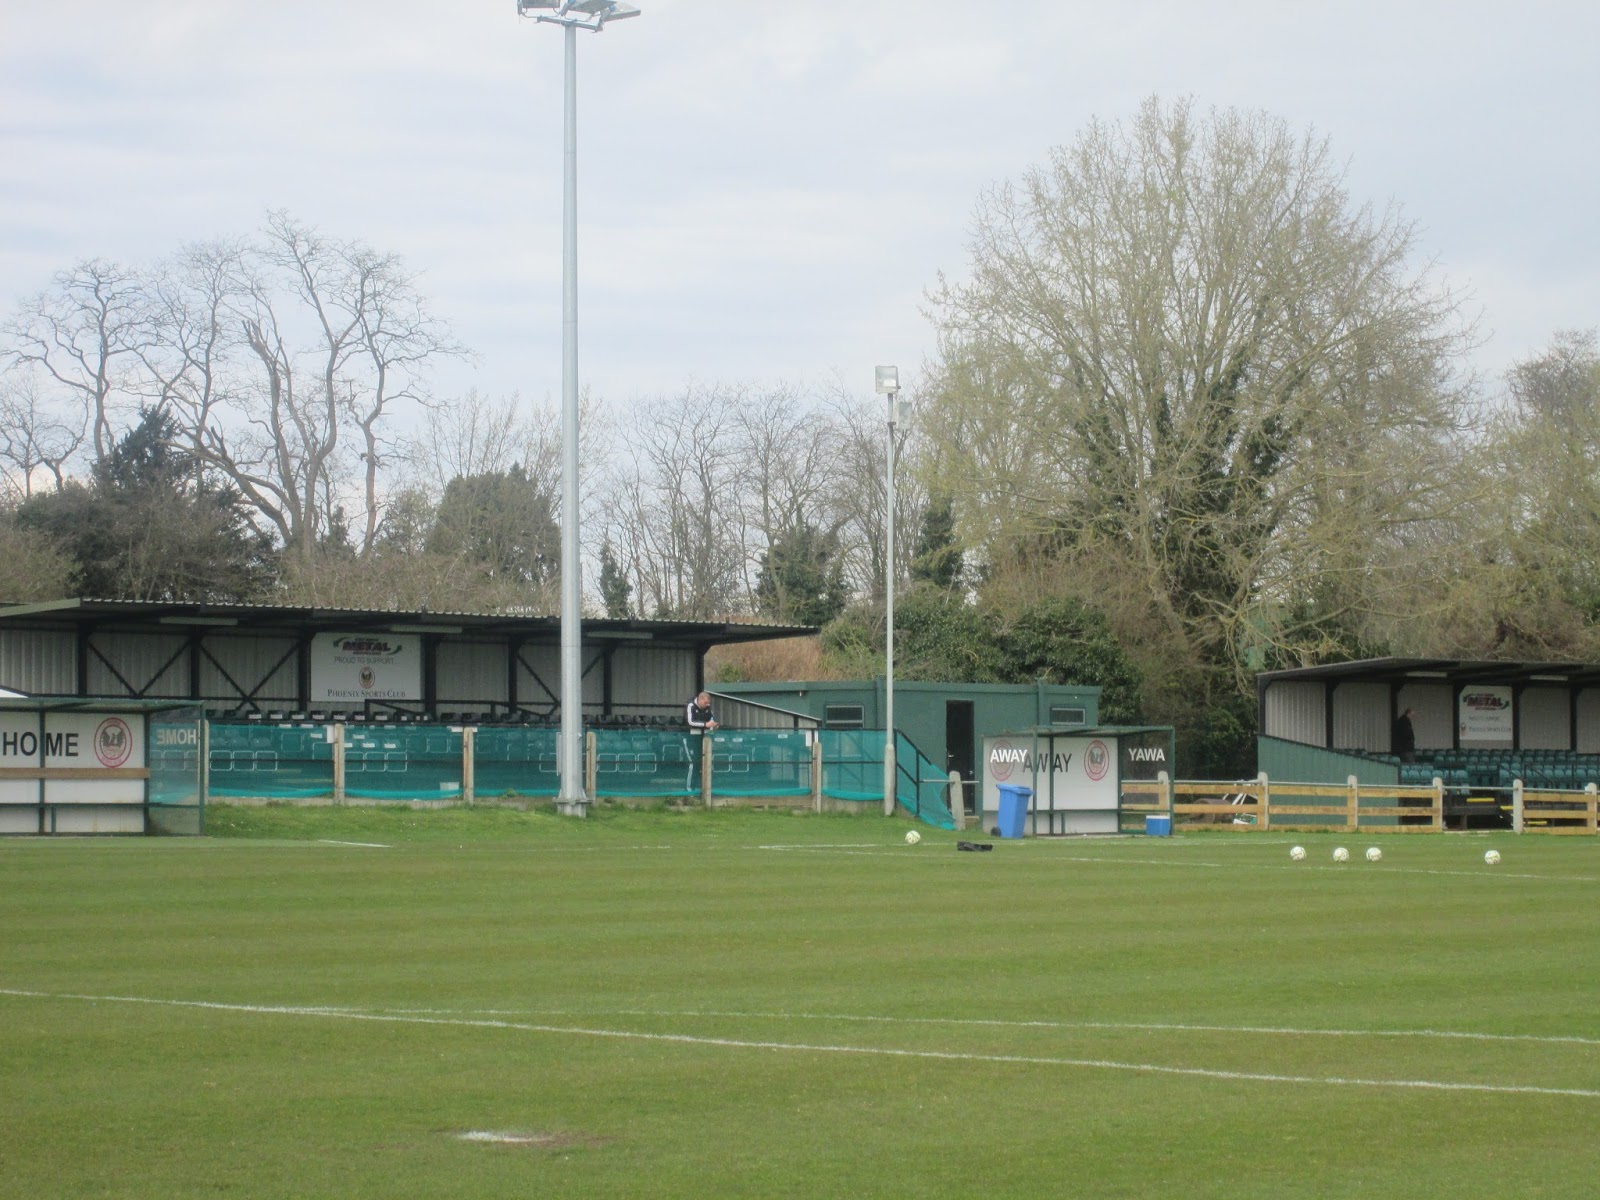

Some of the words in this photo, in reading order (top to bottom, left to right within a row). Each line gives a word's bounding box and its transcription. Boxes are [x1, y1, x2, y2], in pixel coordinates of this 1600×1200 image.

[334, 656, 356, 664] PROUD
[357, 656, 365, 665] TO
[366, 657, 394, 665] SUPPORT
[2, 732, 79, 757] HOME
[989, 749, 1028, 763] AWAY
[1022, 753, 1073, 773] AWAY
